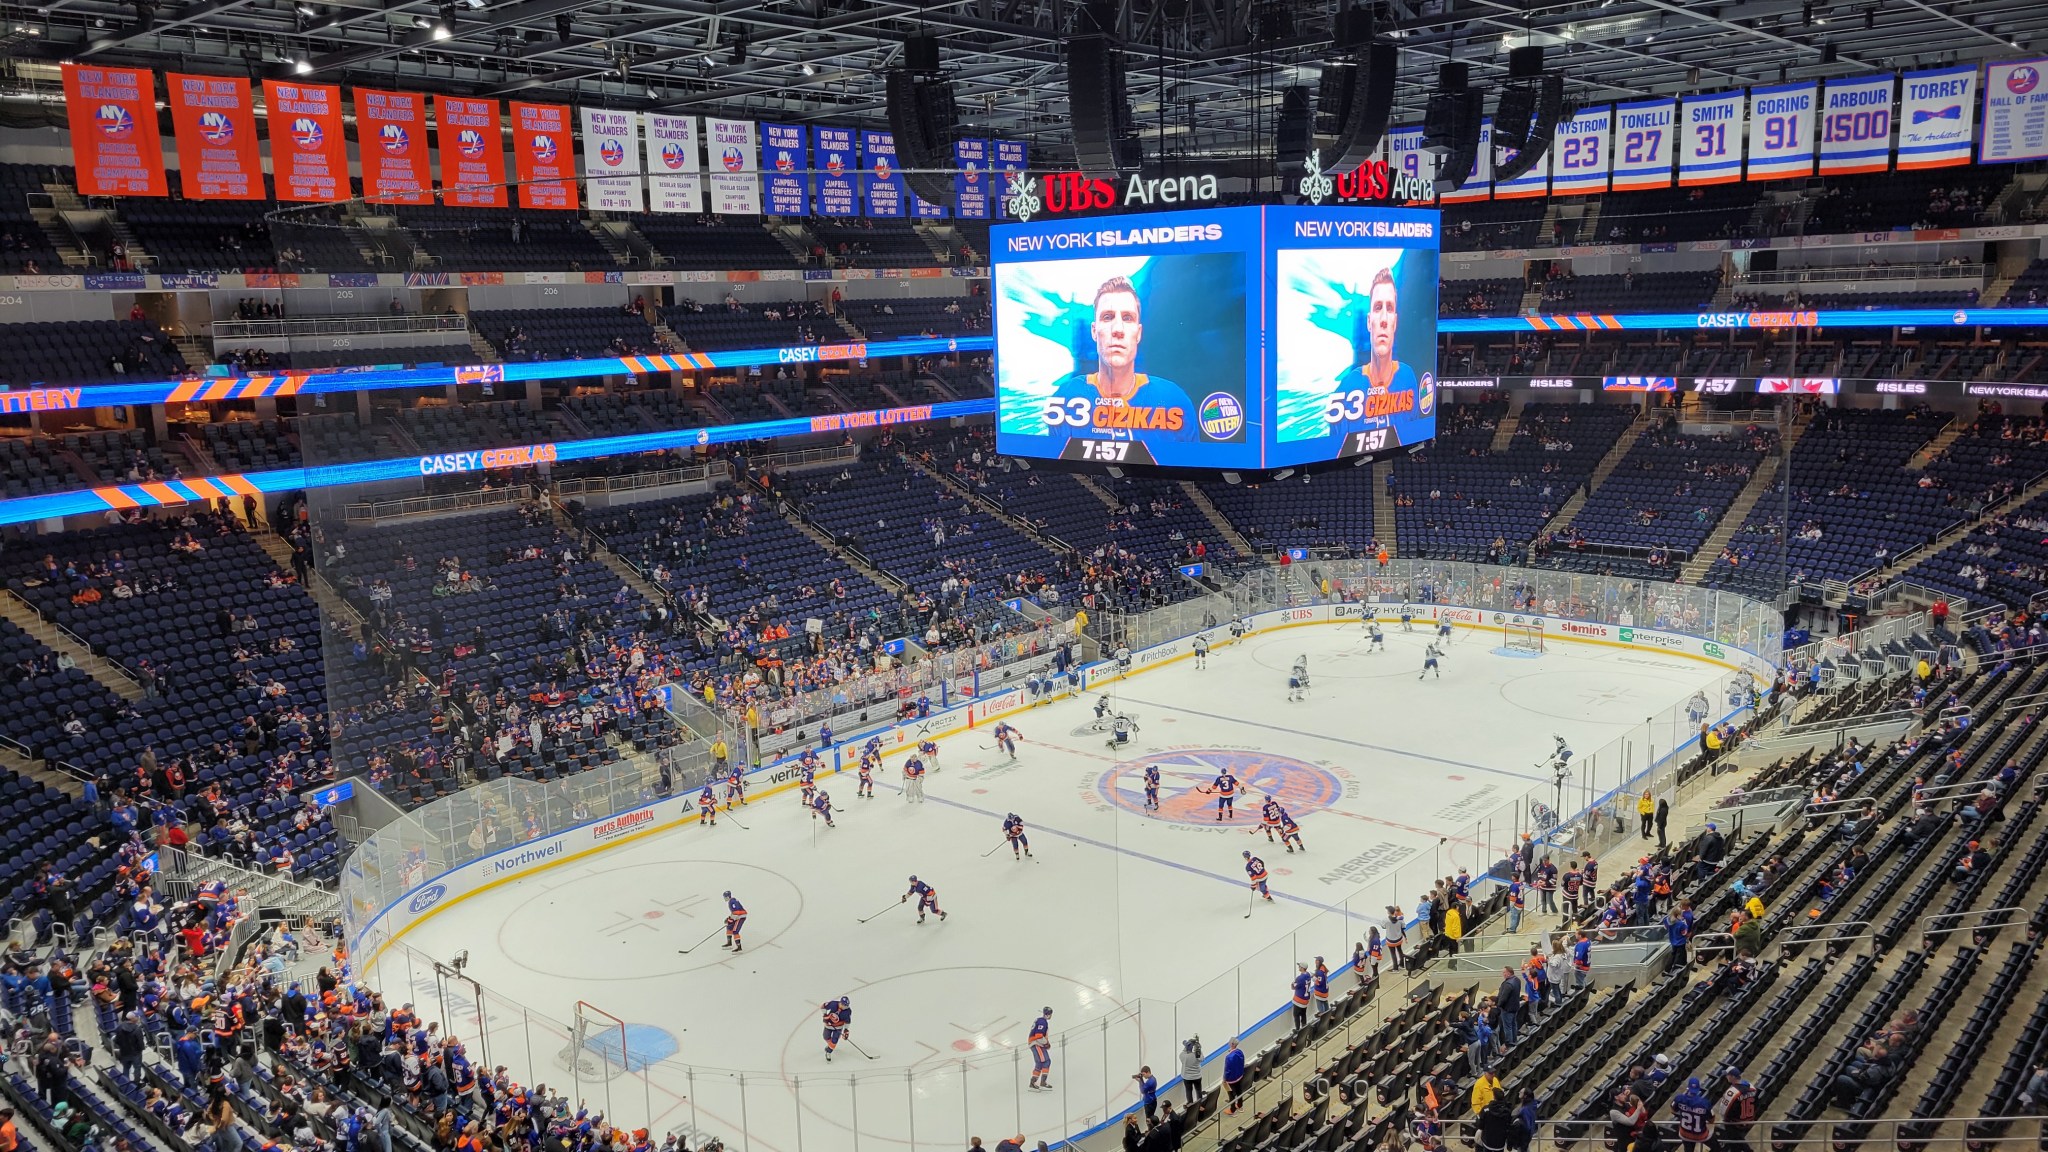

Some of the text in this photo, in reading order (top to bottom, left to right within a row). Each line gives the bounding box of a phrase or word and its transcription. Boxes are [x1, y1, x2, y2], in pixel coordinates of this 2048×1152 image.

[77, 69, 137, 86] NEW YORK
[80, 84, 140, 101] ISLANDERS
[182, 78, 236, 95] NEW YORK
[276, 85, 327, 102] NEW YORK
[1910, 79, 1969, 101] TORREY
[184, 93, 240, 108] ISLANDERS
[366, 93, 413, 108] NEW YORK
[1757, 94, 1809, 115] GORING
[1829, 88, 1887, 109] ARBOUR
[1990, 96, 2027, 107] HALL OF
[278, 100, 329, 115] ISLANDERS
[367, 106, 414, 121] ISLANDERS
[445, 100, 489, 115] NEW YORK
[520, 106, 561, 120] NEW YORK
[1692, 104, 1734, 123] SMITH
[447, 112, 490, 127] ISLANDERS
[521, 119, 562, 132] ISLANDERS
[591, 112, 628, 125] NEW YORK
[653, 117, 688, 129] NEW YORK
[1557, 117, 1608, 135] NYSTROM
[1621, 110, 1670, 129] TONELLI
[1823, 109, 1889, 143] 1500
[592, 124, 628, 136] ISLANDERS
[654, 129, 689, 140] ISLANDERS
[714, 123, 747, 134] NEW YORK
[768, 127, 799, 139] NEW YORK
[820, 130, 849, 141] NEW YORK
[1764, 114, 1799, 151] 91
[715, 133, 748, 144] ISLANDERS
[769, 137, 799, 149] ISLANDERS
[821, 140, 849, 151] ISLANDERS
[867, 134, 880, 144] NEW
[958, 140, 982, 150] NEW YORK
[1695, 123, 1727, 157] 31
[868, 144, 896, 154] ISLANDERS
[999, 143, 1022, 152] NEW YORK
[1563, 135, 1599, 169] 23
[1624, 129, 1663, 164] 27
[959, 150, 983, 160] ISLANDERS
[999, 152, 1022, 162] ISLANDERS
[1404, 153, 1419, 178] 9
[773, 178, 799, 187] CAMPBELL
[824, 180, 849, 188] CAMPBELL
[872, 182, 895, 191] CAMPBELL
[1337, 159, 1433, 202] UBS Arena
[771, 187, 802, 196] CONFERENCE
[822, 188, 852, 197] CONFERENCE
[870, 190, 898, 199] CONFERENCE
[1043, 171, 1218, 213] UBS Arena
[773, 195, 801, 205] CHAMPIONS
[824, 196, 851, 205] CHAMPIONS
[872, 199, 897, 207] CHAMPIONS
[1295, 221, 1433, 238] NEW YORK ISLANDERS
[1008, 223, 1222, 252] NEW YORK ISLANDERS
[1864, 247, 1880, 255] 214
[336, 290, 354, 299] 205
[543, 287, 559, 296] 206
[0, 295, 23, 305] 204
[1697, 311, 1818, 328] CASEY CIZIKAS
[332, 338, 350, 347] 205
[778, 344, 867, 364] CASEY CIZIKAS
[1529, 379, 1573, 388] #ISLES
[1693, 378, 1737, 392] 7:57
[1876, 382, 1926, 394] #ISLES
[1969, 386, 1995, 395] NEW
[1996, 387, 2024, 396] YORK
[0, 388, 82, 413] TTERY
[1324, 390, 1365, 424] 53
[1364, 389, 1414, 418] CIZIKAS
[810, 406, 933, 432] NEW YORK LOTTERY
[1041, 396, 1092, 427] 53
[1092, 406, 1184, 431] CIZIKAS
[1219, 406, 1239, 417] YORK
[1204, 416, 1241, 434] LOTTERY
[1355, 429, 1388, 453] 7:57
[1082, 440, 1130, 461] 7:57
[419, 444, 557, 476] CASEY CIZIKAS
[1291, 609, 1313, 620] UBS
[1562, 621, 1607, 637] slomin's
[1624, 631, 1682, 646] enterprise
[1145, 645, 1178, 663] PitchBook
[1617, 656, 1697, 671] verizon
[989, 694, 1017, 714] Coca-Cola
[930, 714, 957, 728] ARCTIX
[771, 770, 801, 785] veriz
[1221, 781, 1229, 789] 3
[593, 809, 655, 836] Parts Authority
[494, 840, 563, 873] Northwell
[1318, 841, 1399, 885] AMERICAN
[1346, 845, 1417, 884] EXPRESS
[414, 887, 440, 911] Ford
[1740, 1097, 1755, 1119] 16
[1681, 1111, 1702, 1133] 21
